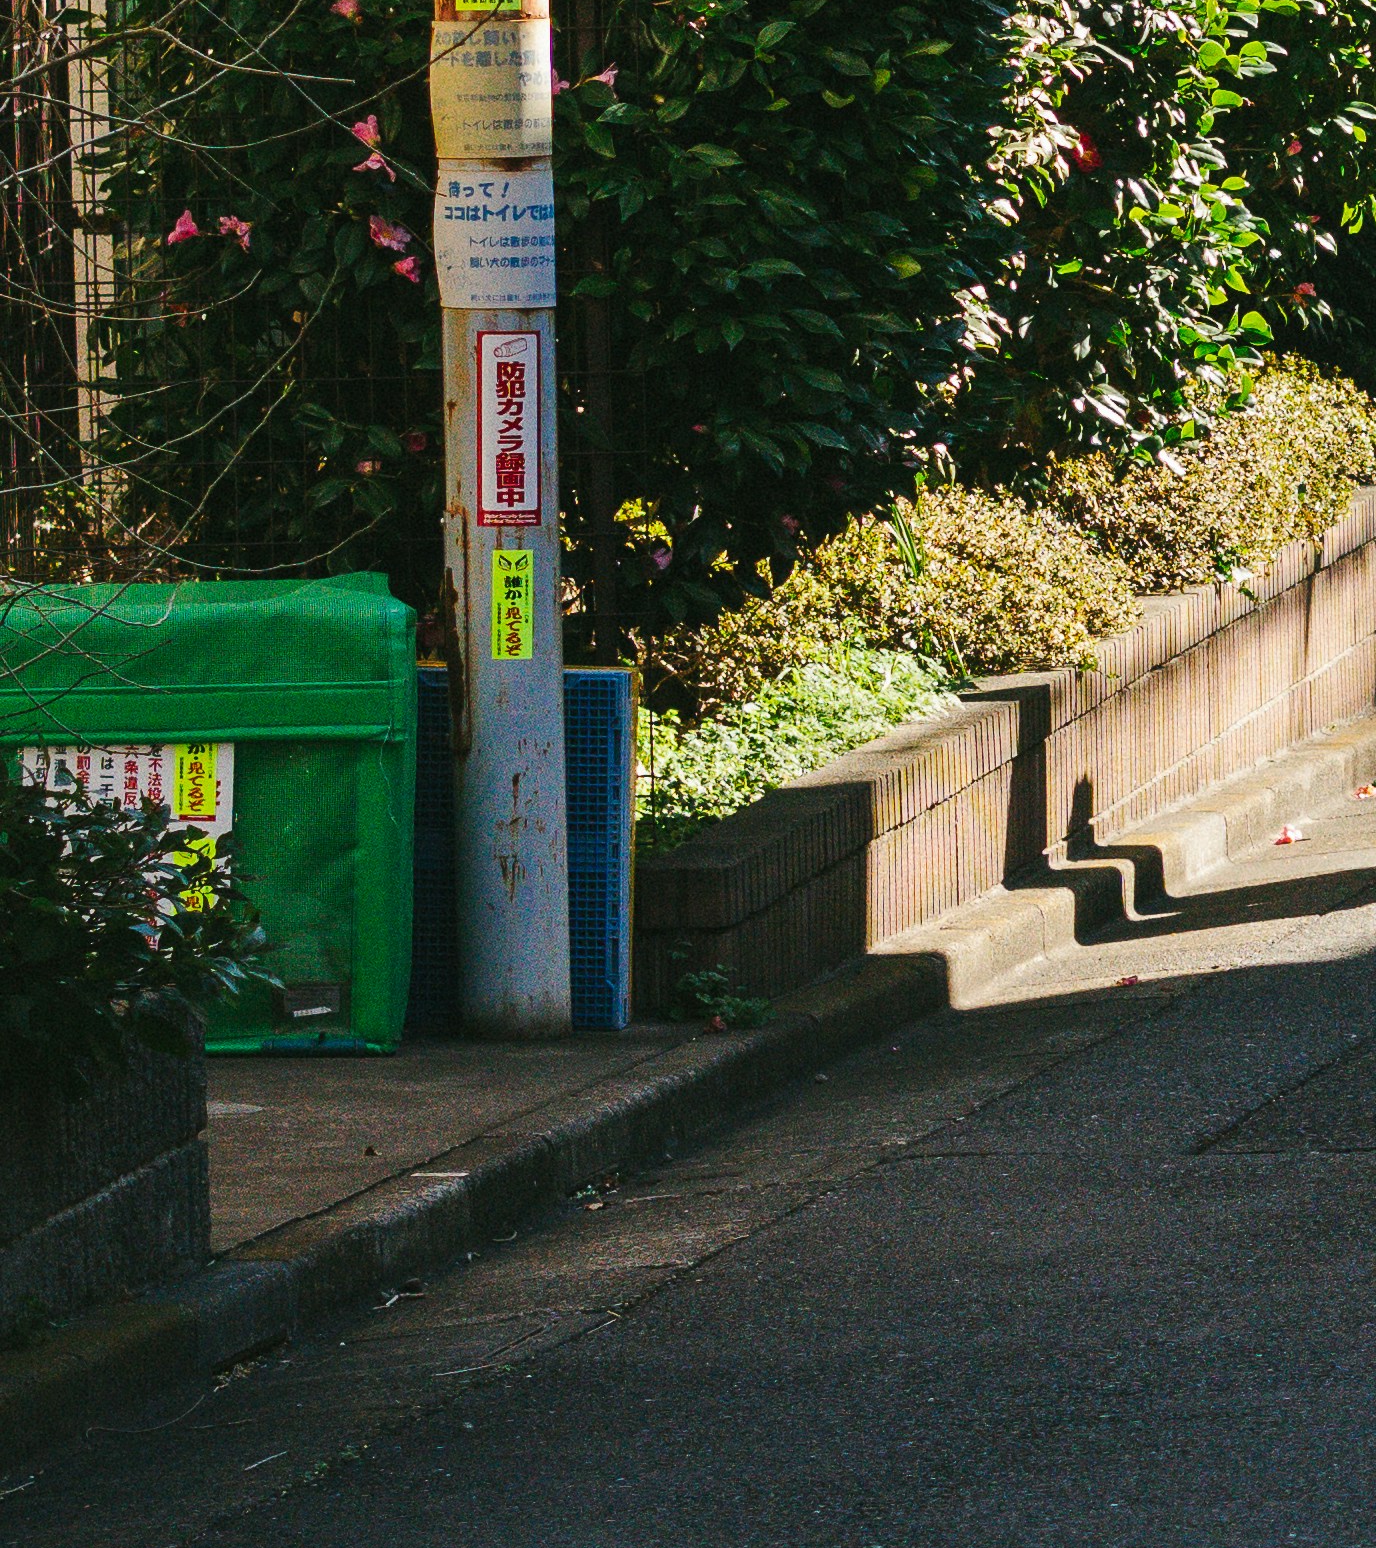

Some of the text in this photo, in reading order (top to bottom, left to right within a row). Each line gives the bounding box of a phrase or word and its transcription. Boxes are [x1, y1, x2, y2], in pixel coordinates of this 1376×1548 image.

[448, 181, 510, 198] 待って！
[495, 360, 526, 508] 防犯カメラ録画中
[503, 575, 523, 656] 誰か・見てるぞ
